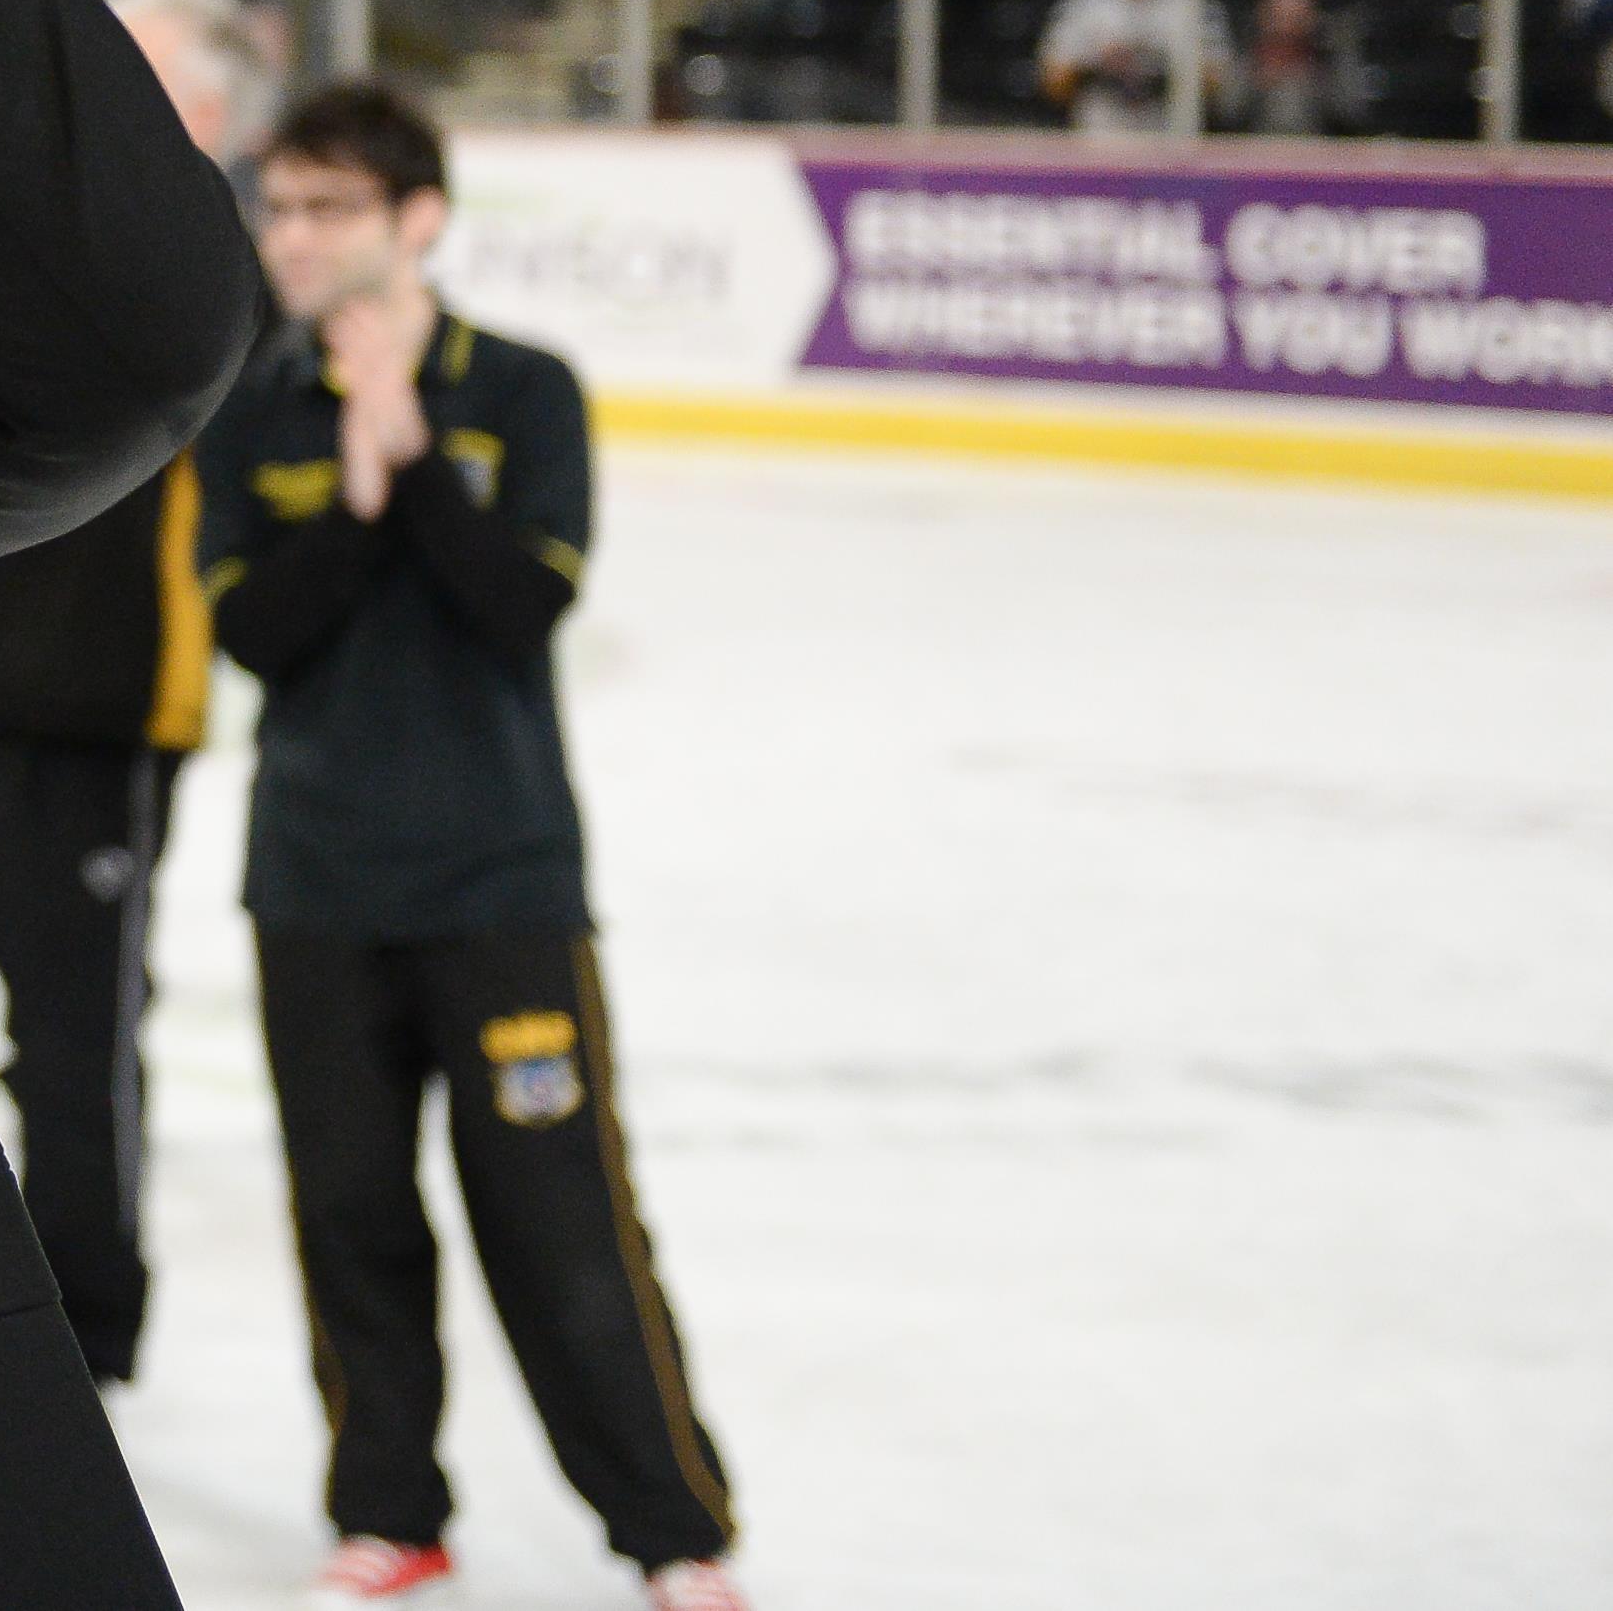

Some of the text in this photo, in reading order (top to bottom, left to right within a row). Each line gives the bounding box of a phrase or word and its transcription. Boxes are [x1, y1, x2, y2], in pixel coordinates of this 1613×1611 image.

[843, 189, 1486, 294] ESSENTIAL COVER
[843, 280, 1227, 367] WHENEVER
[1231, 291, 1393, 377] YOU
